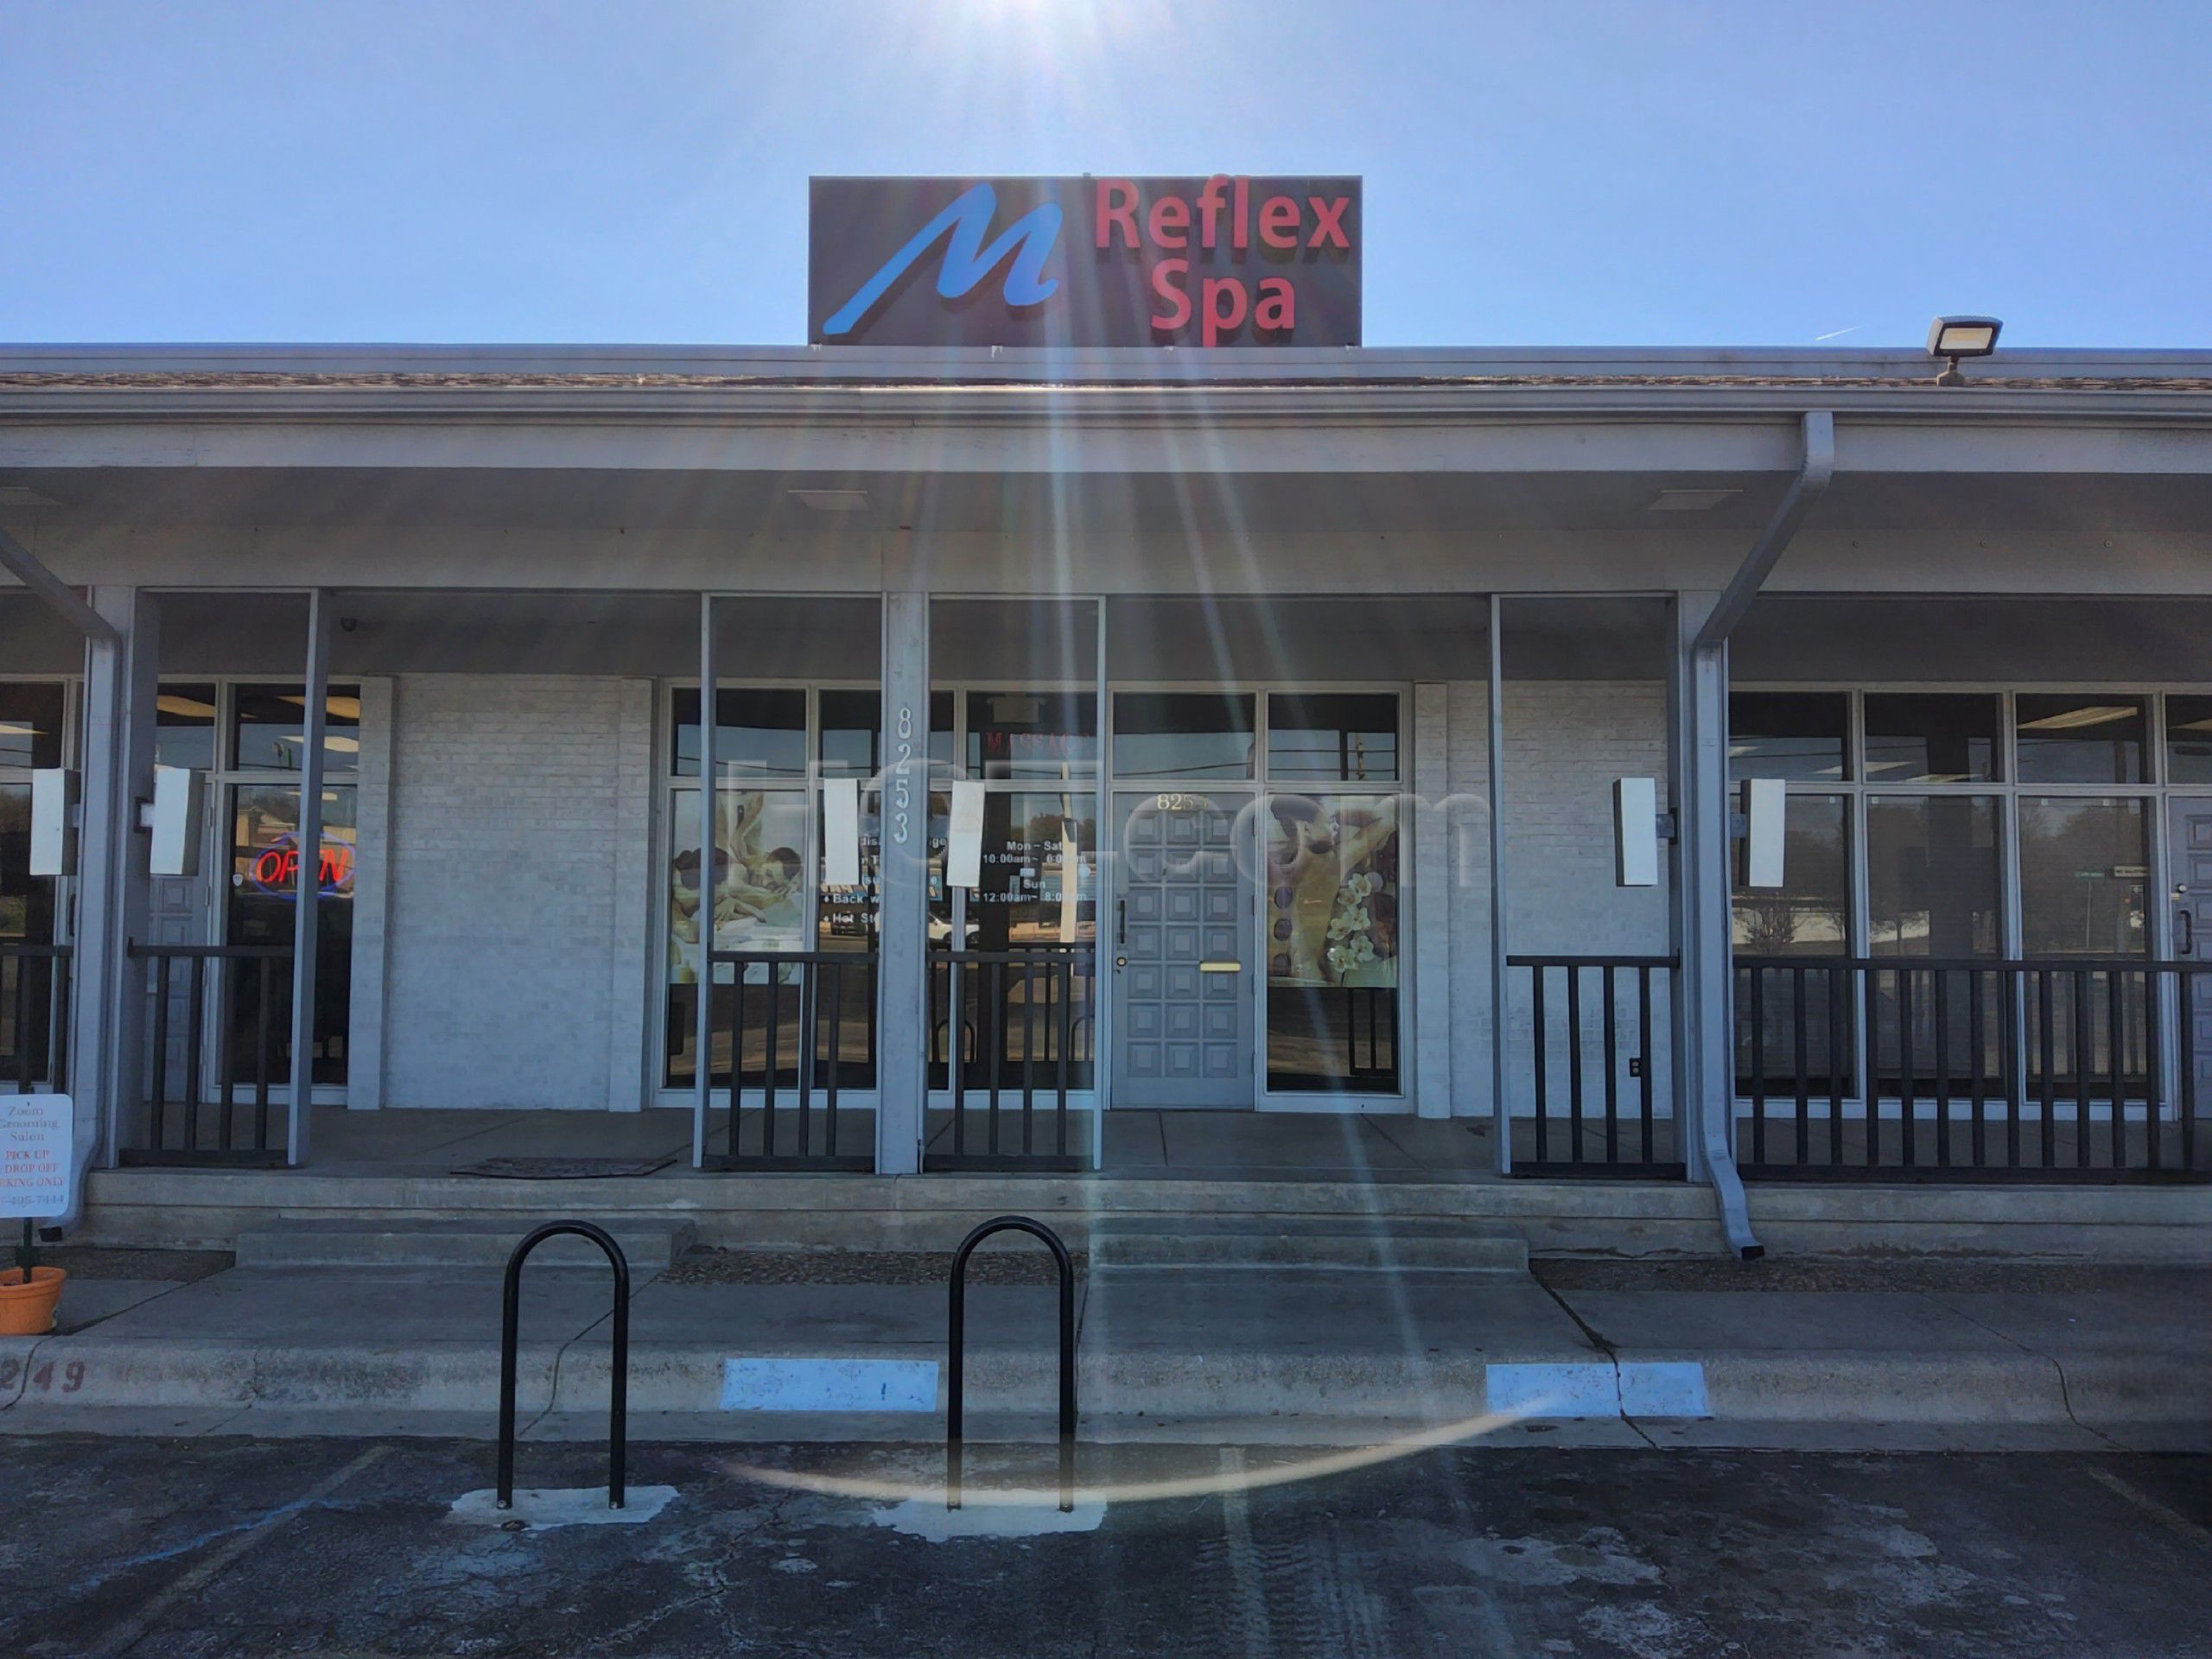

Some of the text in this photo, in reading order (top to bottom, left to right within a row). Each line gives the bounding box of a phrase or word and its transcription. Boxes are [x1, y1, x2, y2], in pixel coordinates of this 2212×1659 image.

[1096, 174, 1350, 249] Reflex
[823, 182, 1062, 334] M
[1150, 258, 1295, 347] Spa
[892, 707, 912, 846] 8253
[1006, 841, 1032, 850] Mon
[1043, 841, 1064, 850] Sat
[255, 849, 349, 883] OPN
[1022, 879, 1046, 889] Sun
[832, 893, 864, 904] Back
[8, 1105, 44, 1116] Zoom
[10, 1131, 45, 1141] Salon
[6, 1149, 49, 1160] PICK UP
[4, 1162, 59, 1173] DROP OFF
[36, 1176, 65, 1187] ONLY
